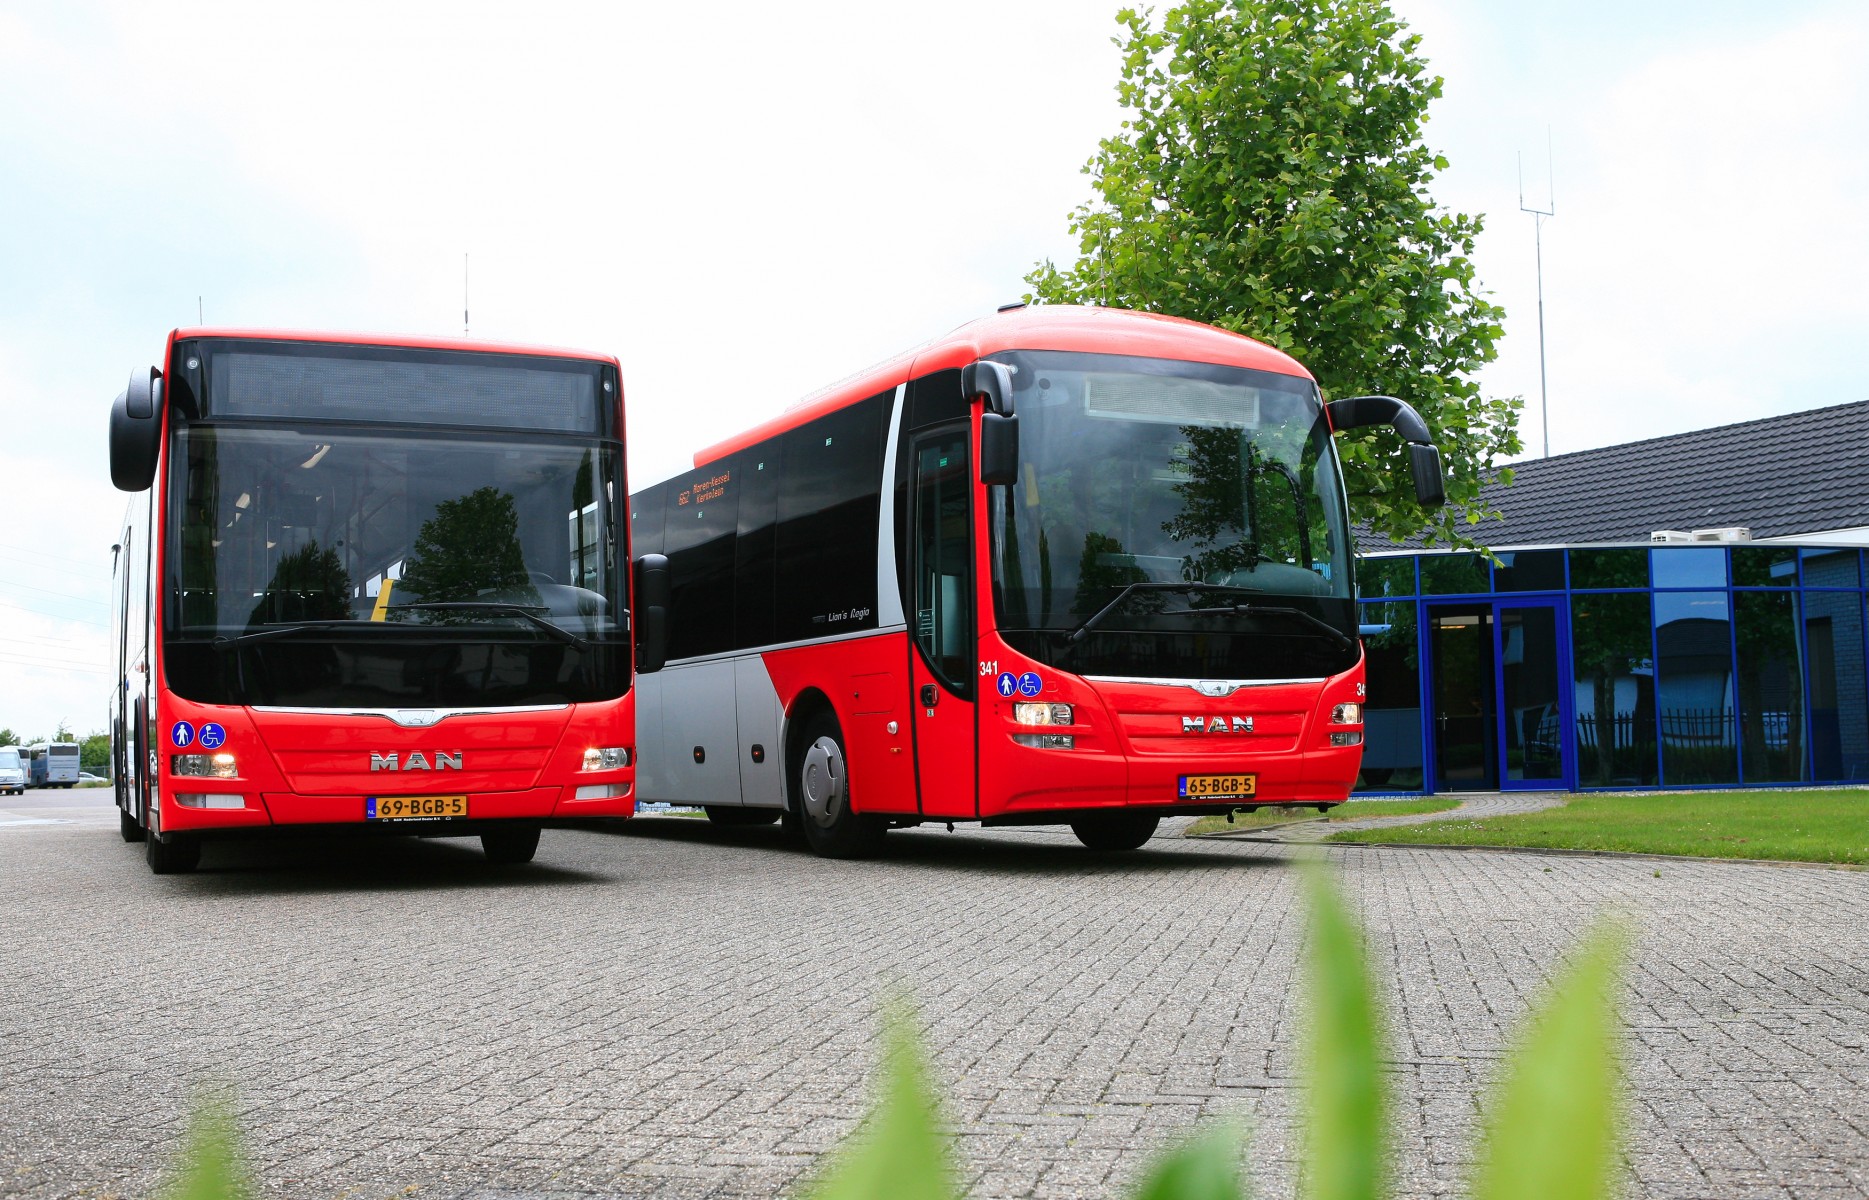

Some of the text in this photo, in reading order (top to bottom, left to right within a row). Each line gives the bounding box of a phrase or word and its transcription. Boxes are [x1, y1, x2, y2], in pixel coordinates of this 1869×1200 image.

[828, 607, 870, 622] Lion's Regio
[980, 660, 998, 676] 341
[1182, 716, 1254, 732] MAN
[370, 751, 463, 771] MAN
[1189, 778, 1252, 793] 65-BGB-5
[381, 799, 462, 815] 69-BGB-5
